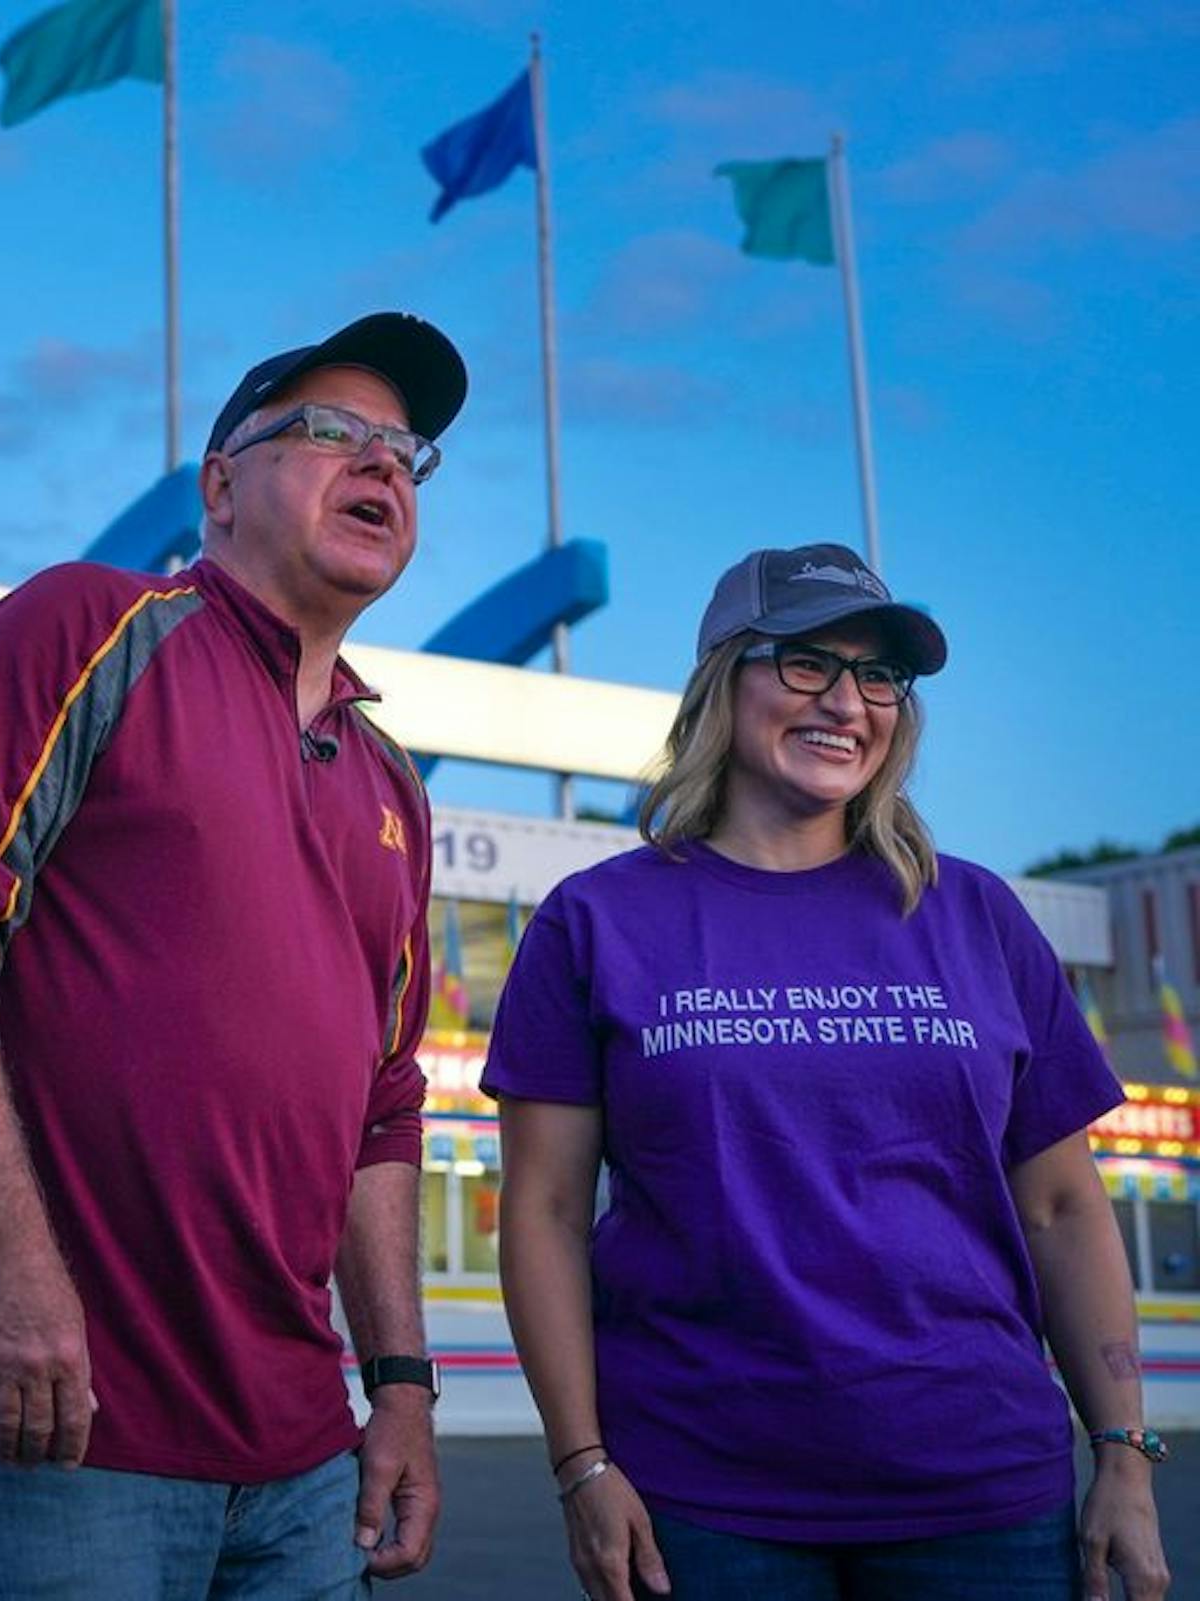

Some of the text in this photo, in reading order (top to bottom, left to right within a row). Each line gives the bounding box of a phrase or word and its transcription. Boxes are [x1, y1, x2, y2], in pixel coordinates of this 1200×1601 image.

[660, 985, 948, 1017] I REALLY ENJOY THE
[641, 1016, 979, 1059] MINNESOTA STATE FAIR
